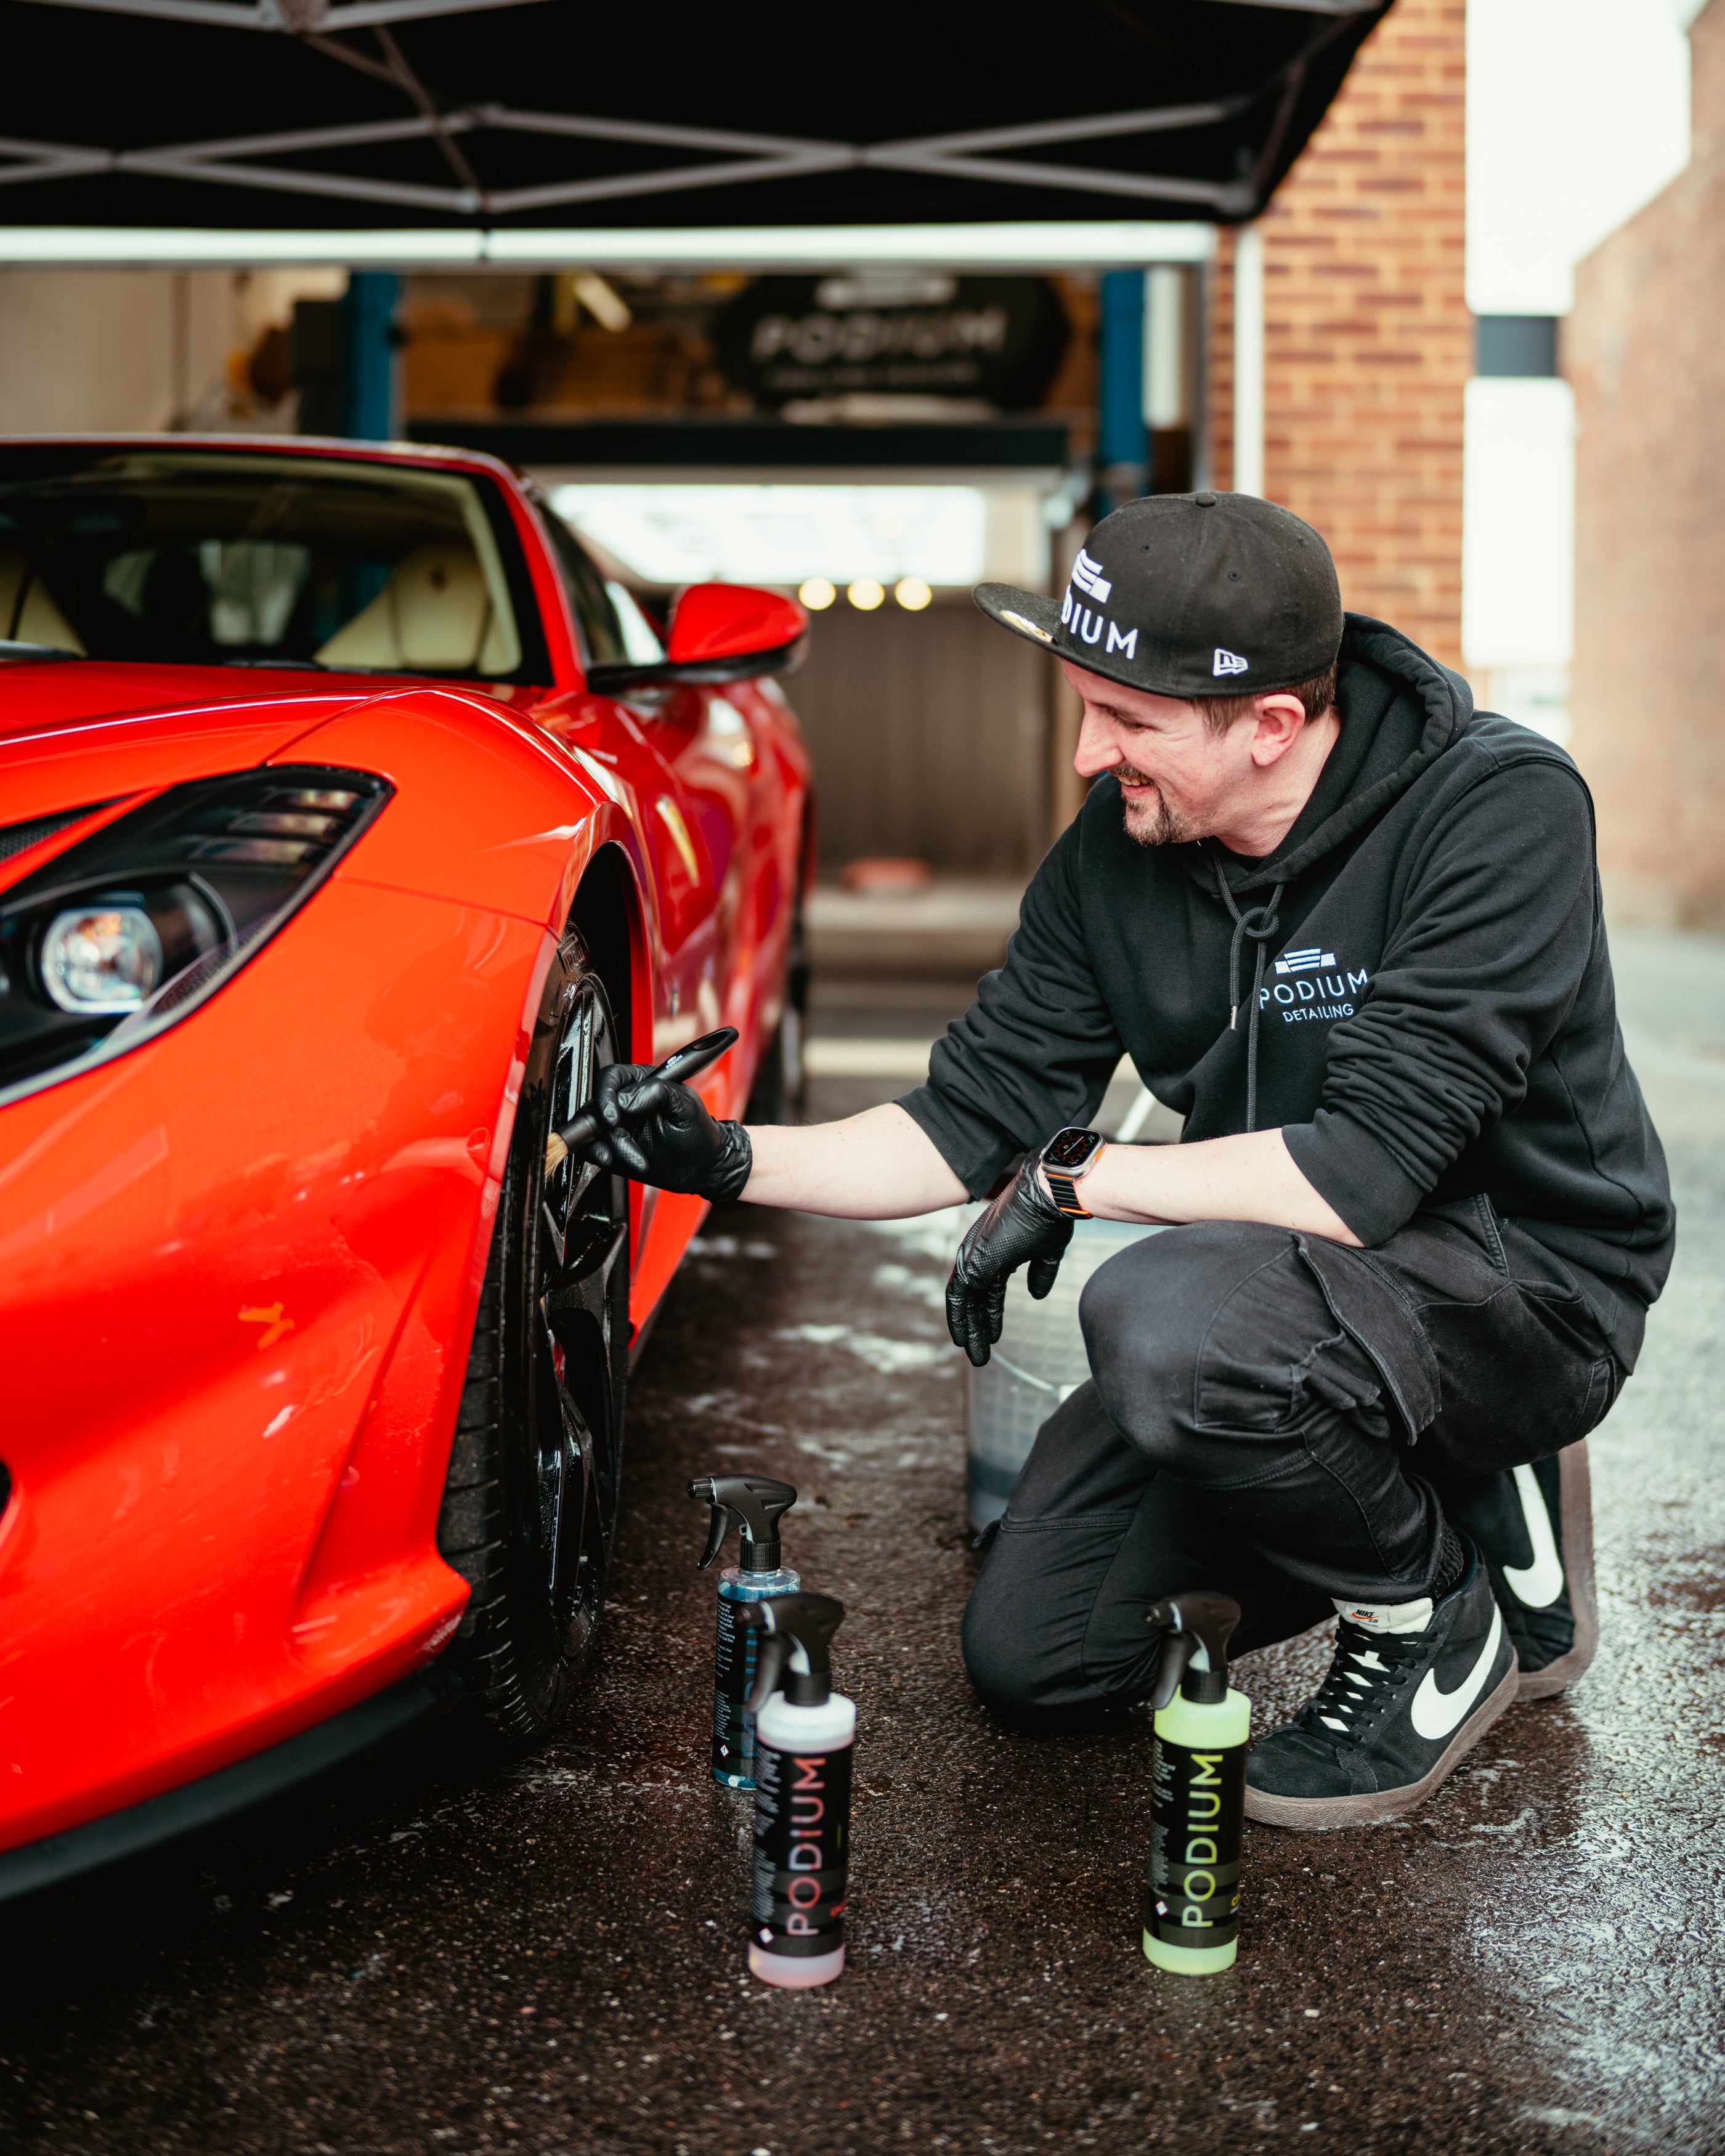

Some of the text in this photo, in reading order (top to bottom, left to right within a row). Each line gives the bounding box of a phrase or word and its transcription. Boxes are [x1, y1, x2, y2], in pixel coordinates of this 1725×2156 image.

[1061, 584, 1138, 660] DIUM
[1259, 968, 1368, 1010] PODIUM
[1283, 1003, 1354, 1023] DETAILING
[665, 1054, 683, 1069] PODIUM
[1355, 1609, 1375, 1618] NIKE
[785, 1756, 827, 1937] PODIUM
[1182, 1753, 1224, 1928] PODIUM
